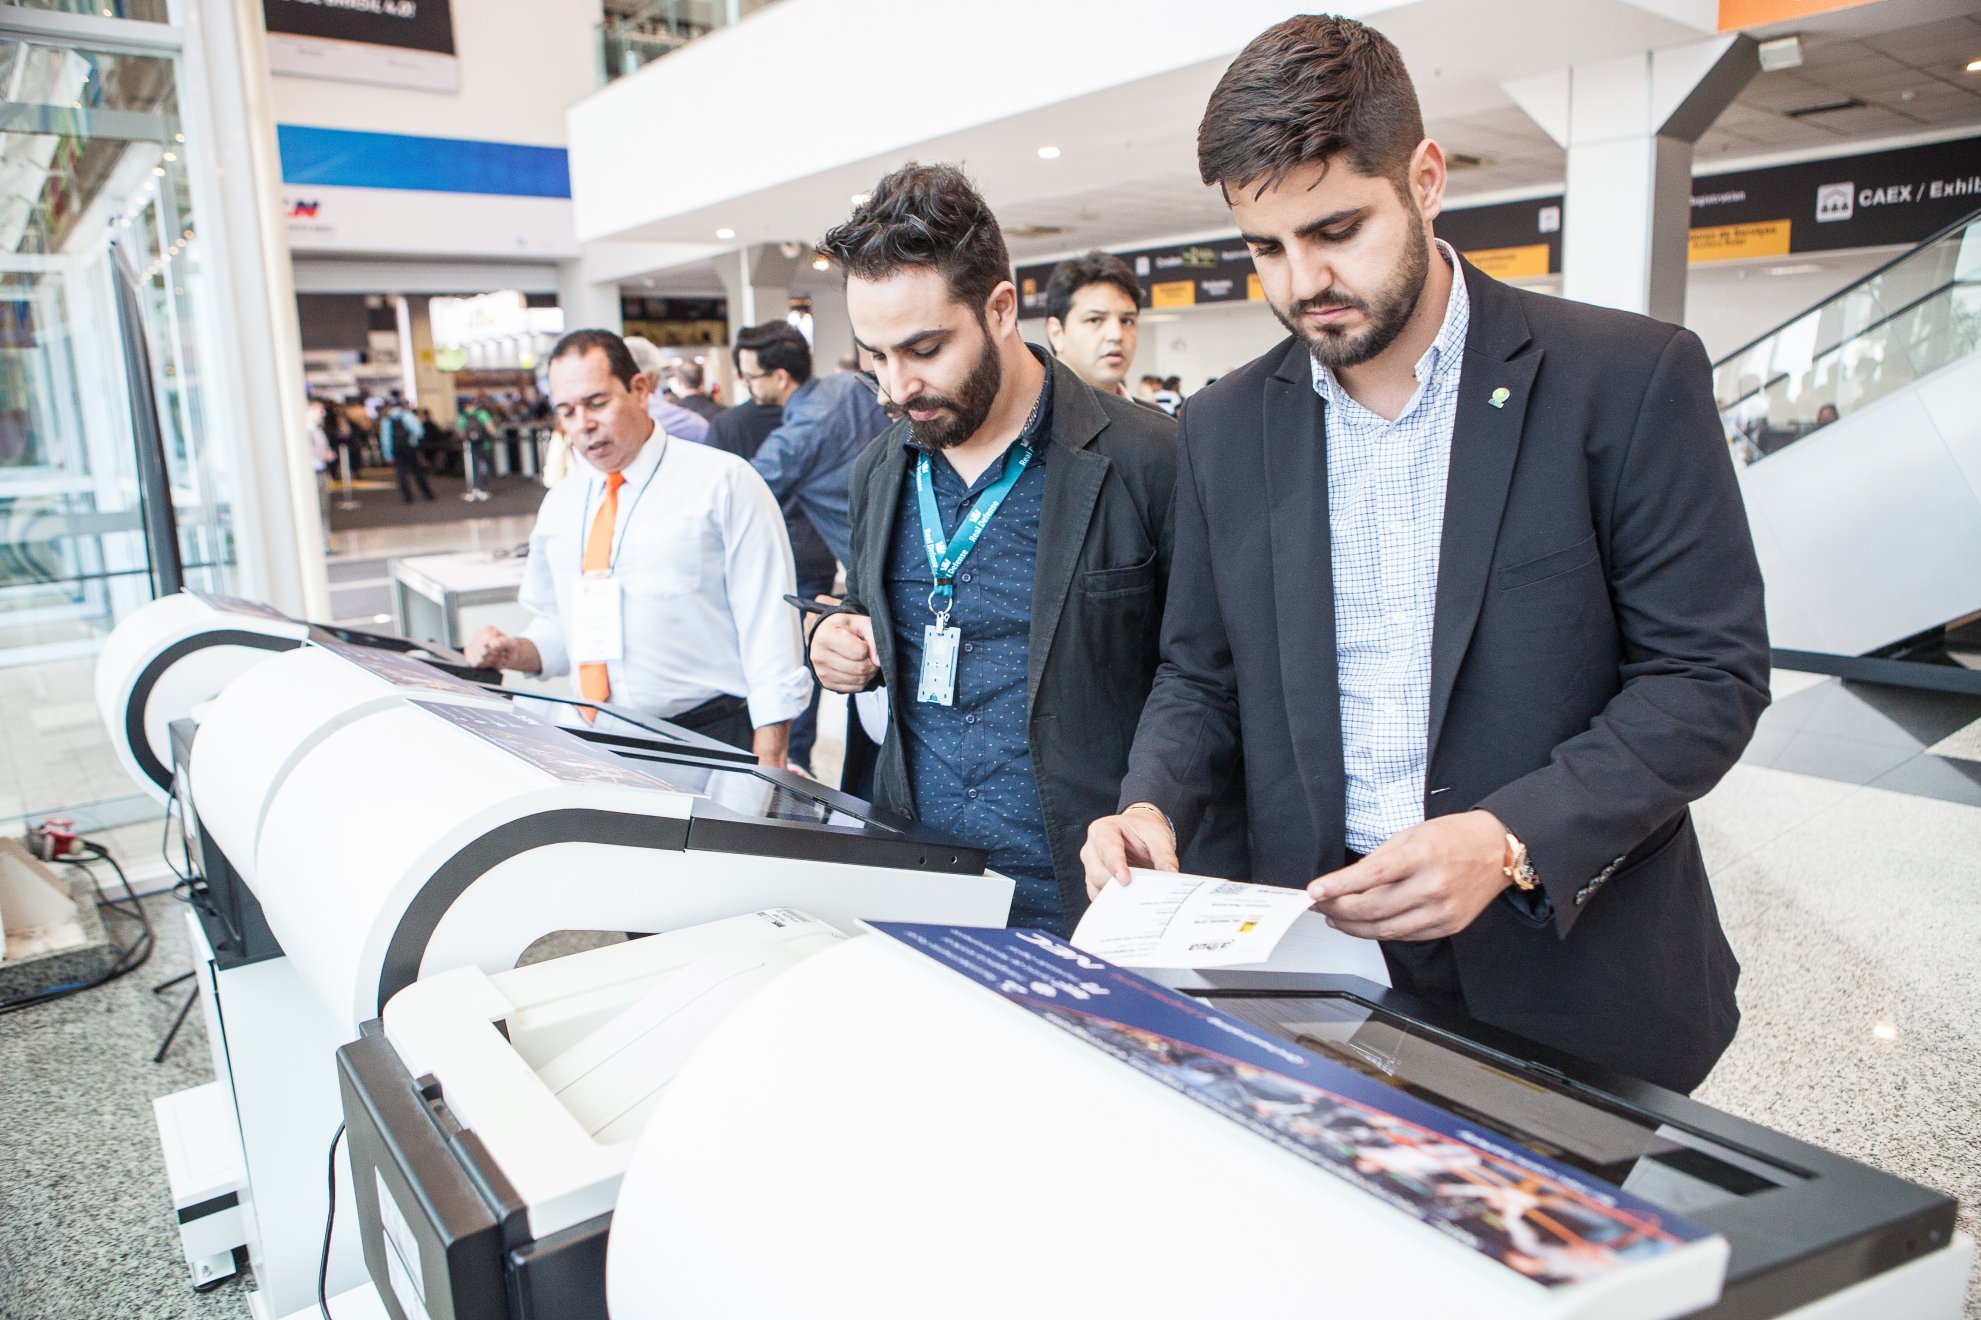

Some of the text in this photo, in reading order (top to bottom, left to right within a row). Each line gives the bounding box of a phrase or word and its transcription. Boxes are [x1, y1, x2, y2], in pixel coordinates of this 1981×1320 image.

[1858, 183, 1913, 208] CAEX
[968, 500, 1000, 543] Real Defense
